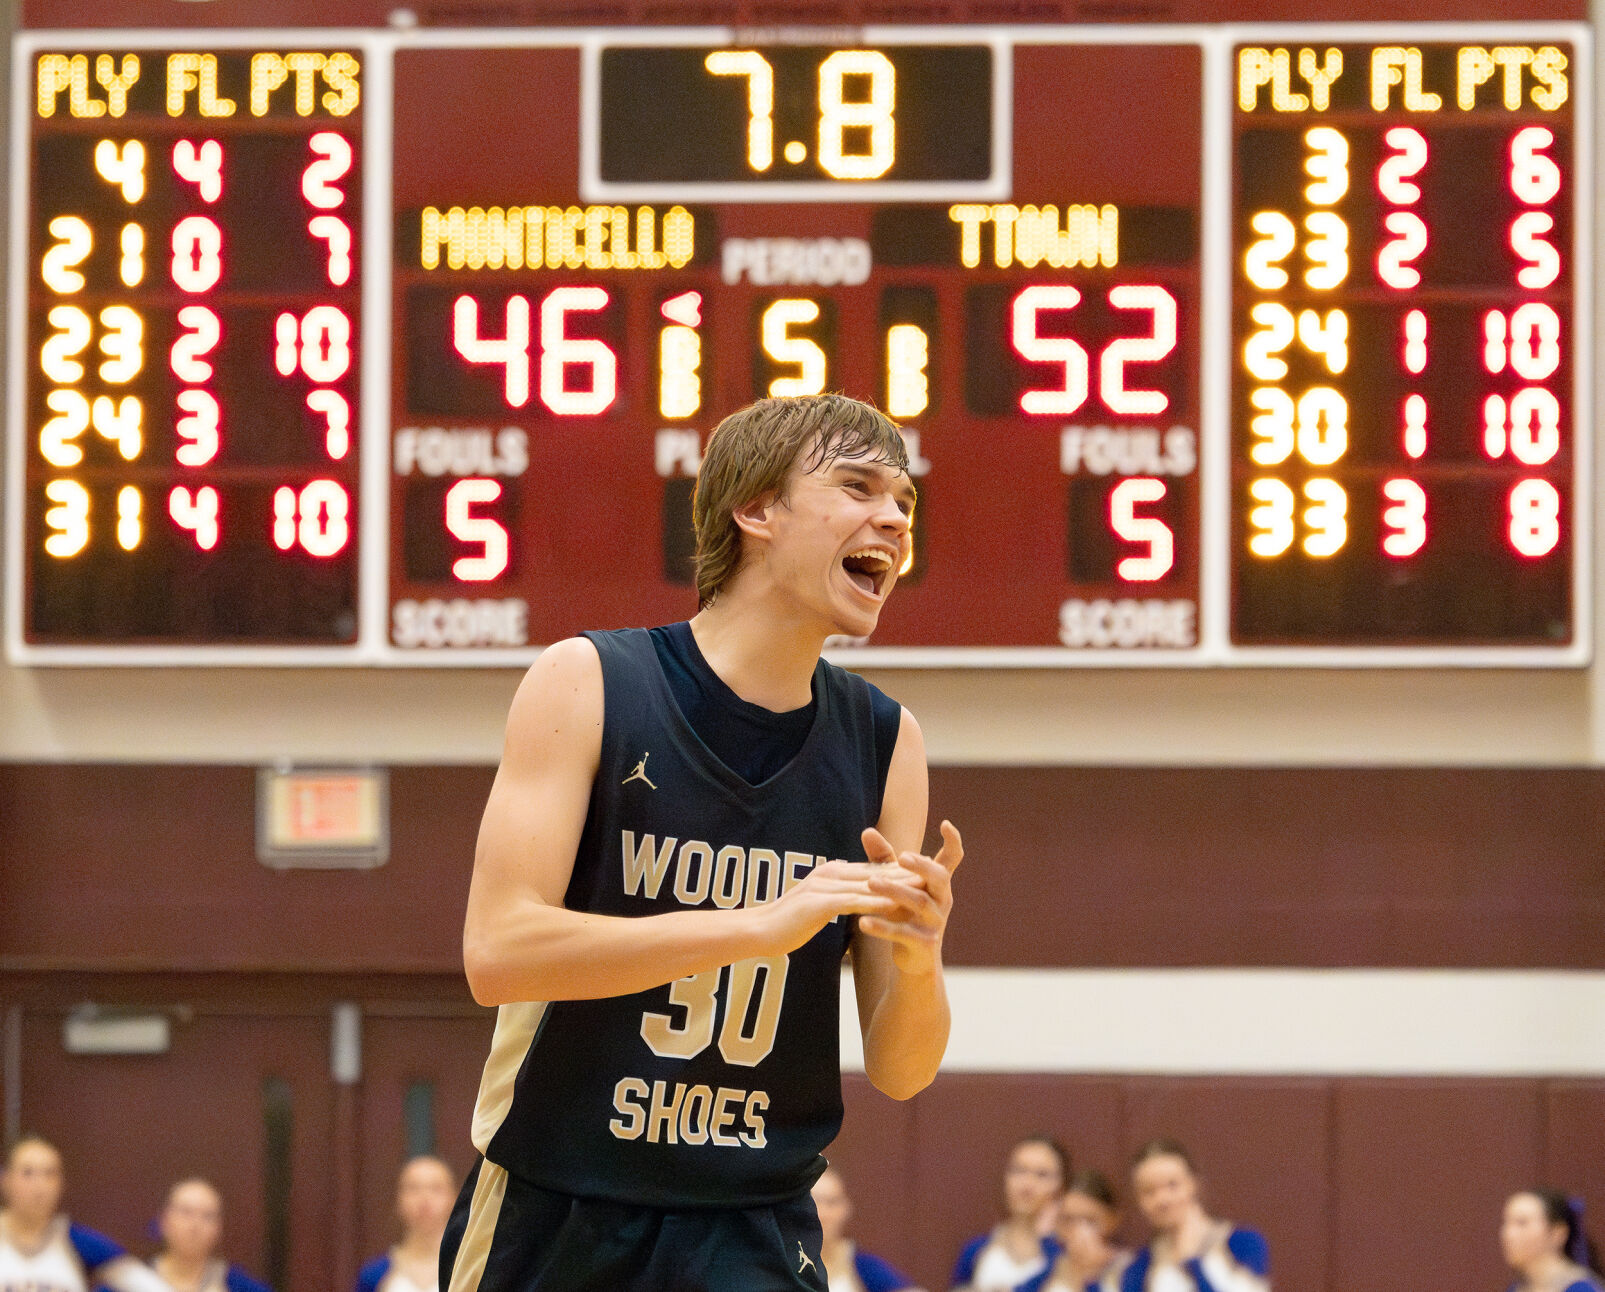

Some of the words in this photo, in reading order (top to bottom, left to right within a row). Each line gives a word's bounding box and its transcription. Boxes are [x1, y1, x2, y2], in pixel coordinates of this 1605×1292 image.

[38, 54, 140, 118] PLY
[167, 54, 236, 117] FL
[251, 53, 360, 117] PTS
[704, 50, 896, 180] 7.8
[1239, 47, 1343, 112] PLY
[1371, 47, 1442, 112] FL
[1457, 47, 1568, 111] PTS
[95, 139, 145, 204] 4
[173, 139, 222, 203] 4
[302, 132, 352, 209] 2
[1305, 127, 1349, 206] 3
[1378, 127, 1428, 205] 2
[1511, 127, 1561, 204] 6
[42, 216, 144, 294] 21
[171, 216, 221, 293] 0
[308, 216, 351, 286] 7
[421, 205, 695, 270] MONTICELLO
[722, 237, 872, 286] PERIOD
[1244, 211, 1349, 291] 23
[1378, 212, 1428, 289] 2
[1511, 212, 1560, 289] 5
[41, 305, 143, 384] 23
[170, 306, 220, 383] 2
[275, 306, 350, 383] 10
[453, 287, 616, 415] 46
[762, 299, 826, 398] 5
[1012, 286, 1177, 415] 52
[1243, 302, 1348, 381] 24
[1405, 310, 1427, 374] 1
[1484, 302, 1560, 380] 10
[40, 389, 142, 467] 24
[176, 389, 219, 466] 3
[306, 389, 349, 460] 7
[394, 426, 529, 476] FOULS
[1060, 426, 1197, 476] FOULS
[1251, 386, 1348, 466] 30
[1405, 394, 1427, 458] 1
[1484, 387, 1560, 465] 10
[45, 479, 141, 557] 31
[169, 486, 218, 550] 4
[273, 479, 348, 557] 10
[446, 479, 508, 581] 5
[1110, 478, 1174, 581] 5
[1250, 477, 1347, 557] 33
[1383, 478, 1427, 556] 3
[1509, 478, 1560, 557] 8
[392, 599, 529, 647] SCORE
[1060, 598, 1197, 647] SCORE
[621, 829, 848, 924] WOODE
[640, 954, 790, 1067] 30
[609, 1076, 771, 1149] SHOES
